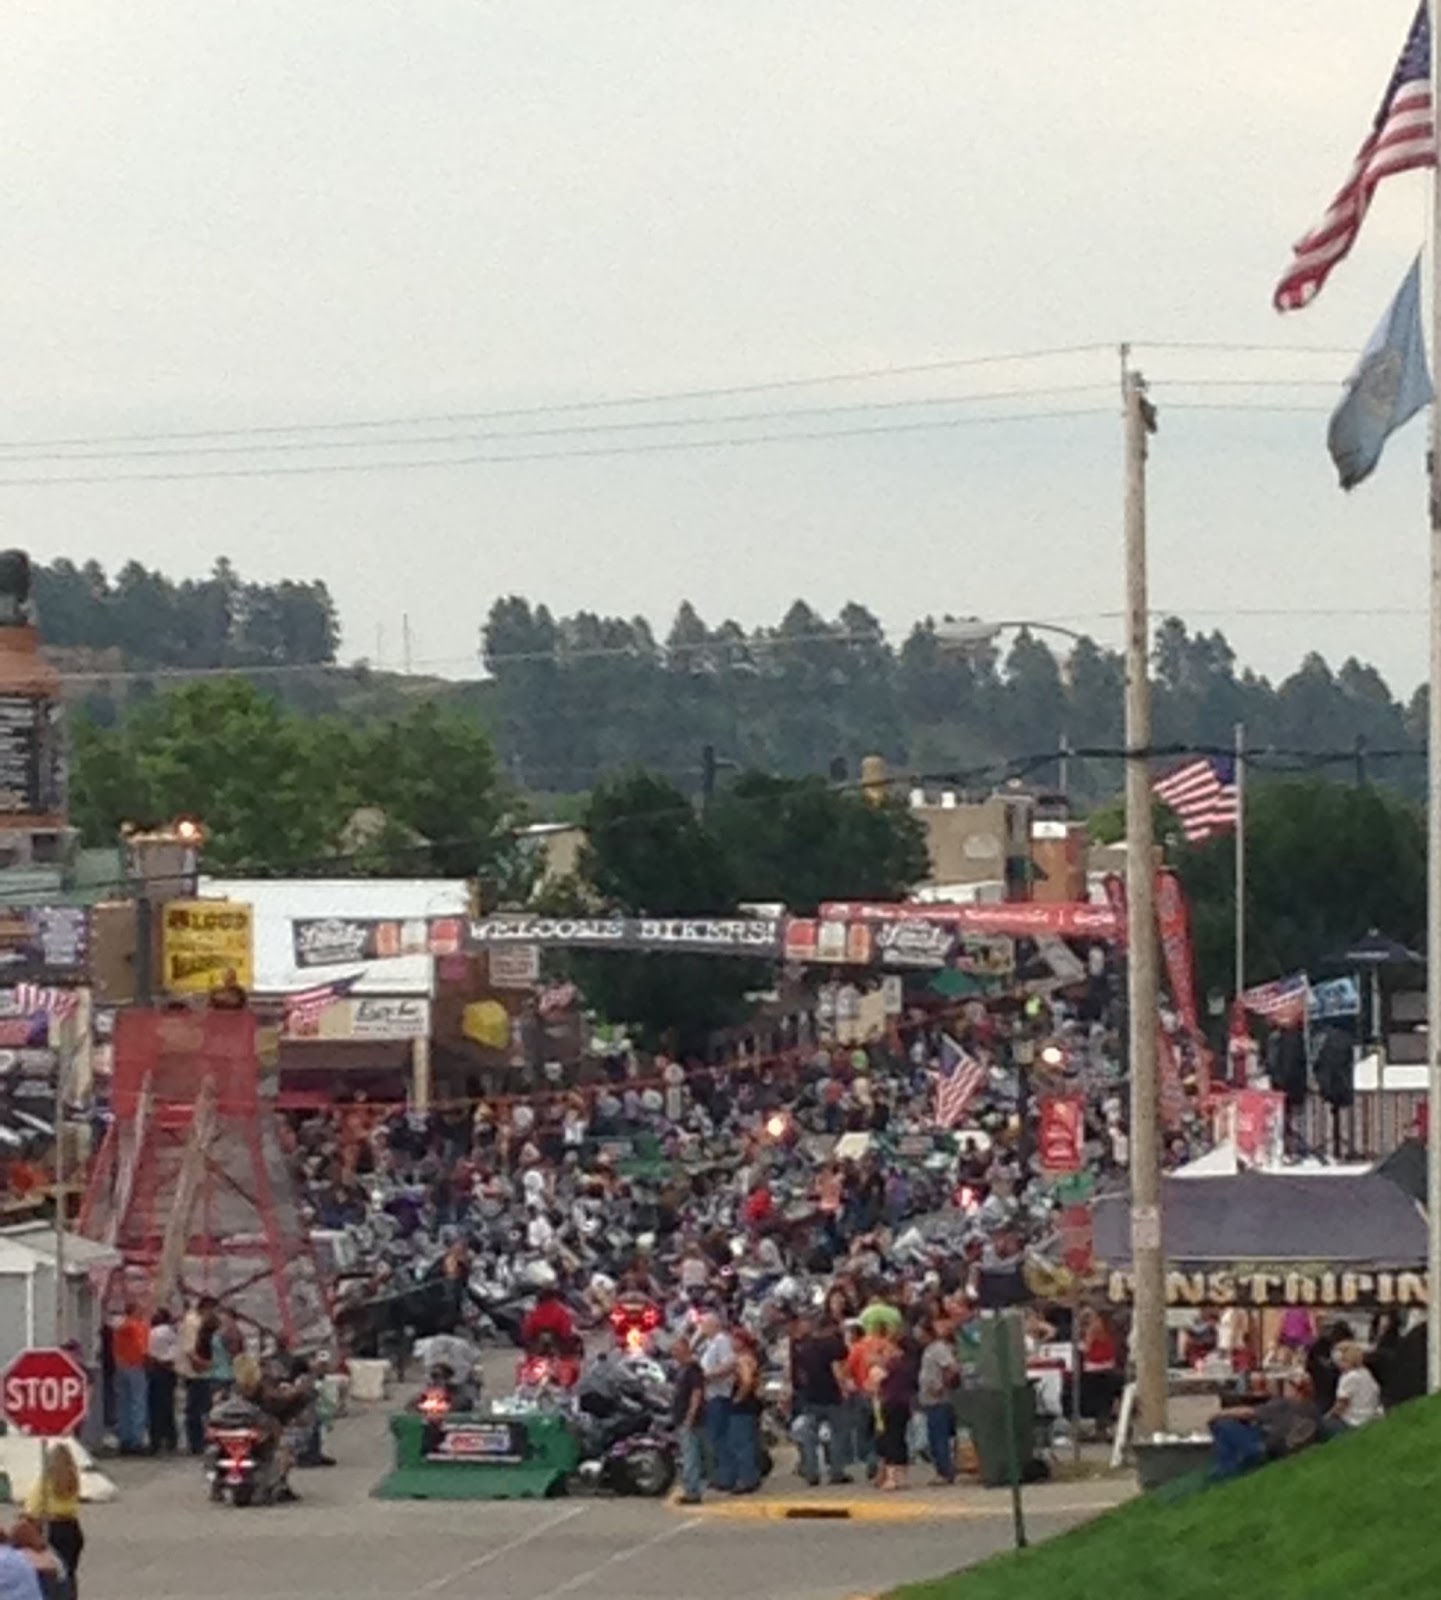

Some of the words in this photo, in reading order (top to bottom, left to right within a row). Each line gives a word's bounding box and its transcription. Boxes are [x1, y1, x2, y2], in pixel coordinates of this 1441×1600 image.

[470, 920, 623, 940] WELCOME
[639, 920, 776, 944] BIKERS!
[1109, 1270, 1429, 1304] PNSTRIPIN
[6, 1377, 80, 1411] STOP
